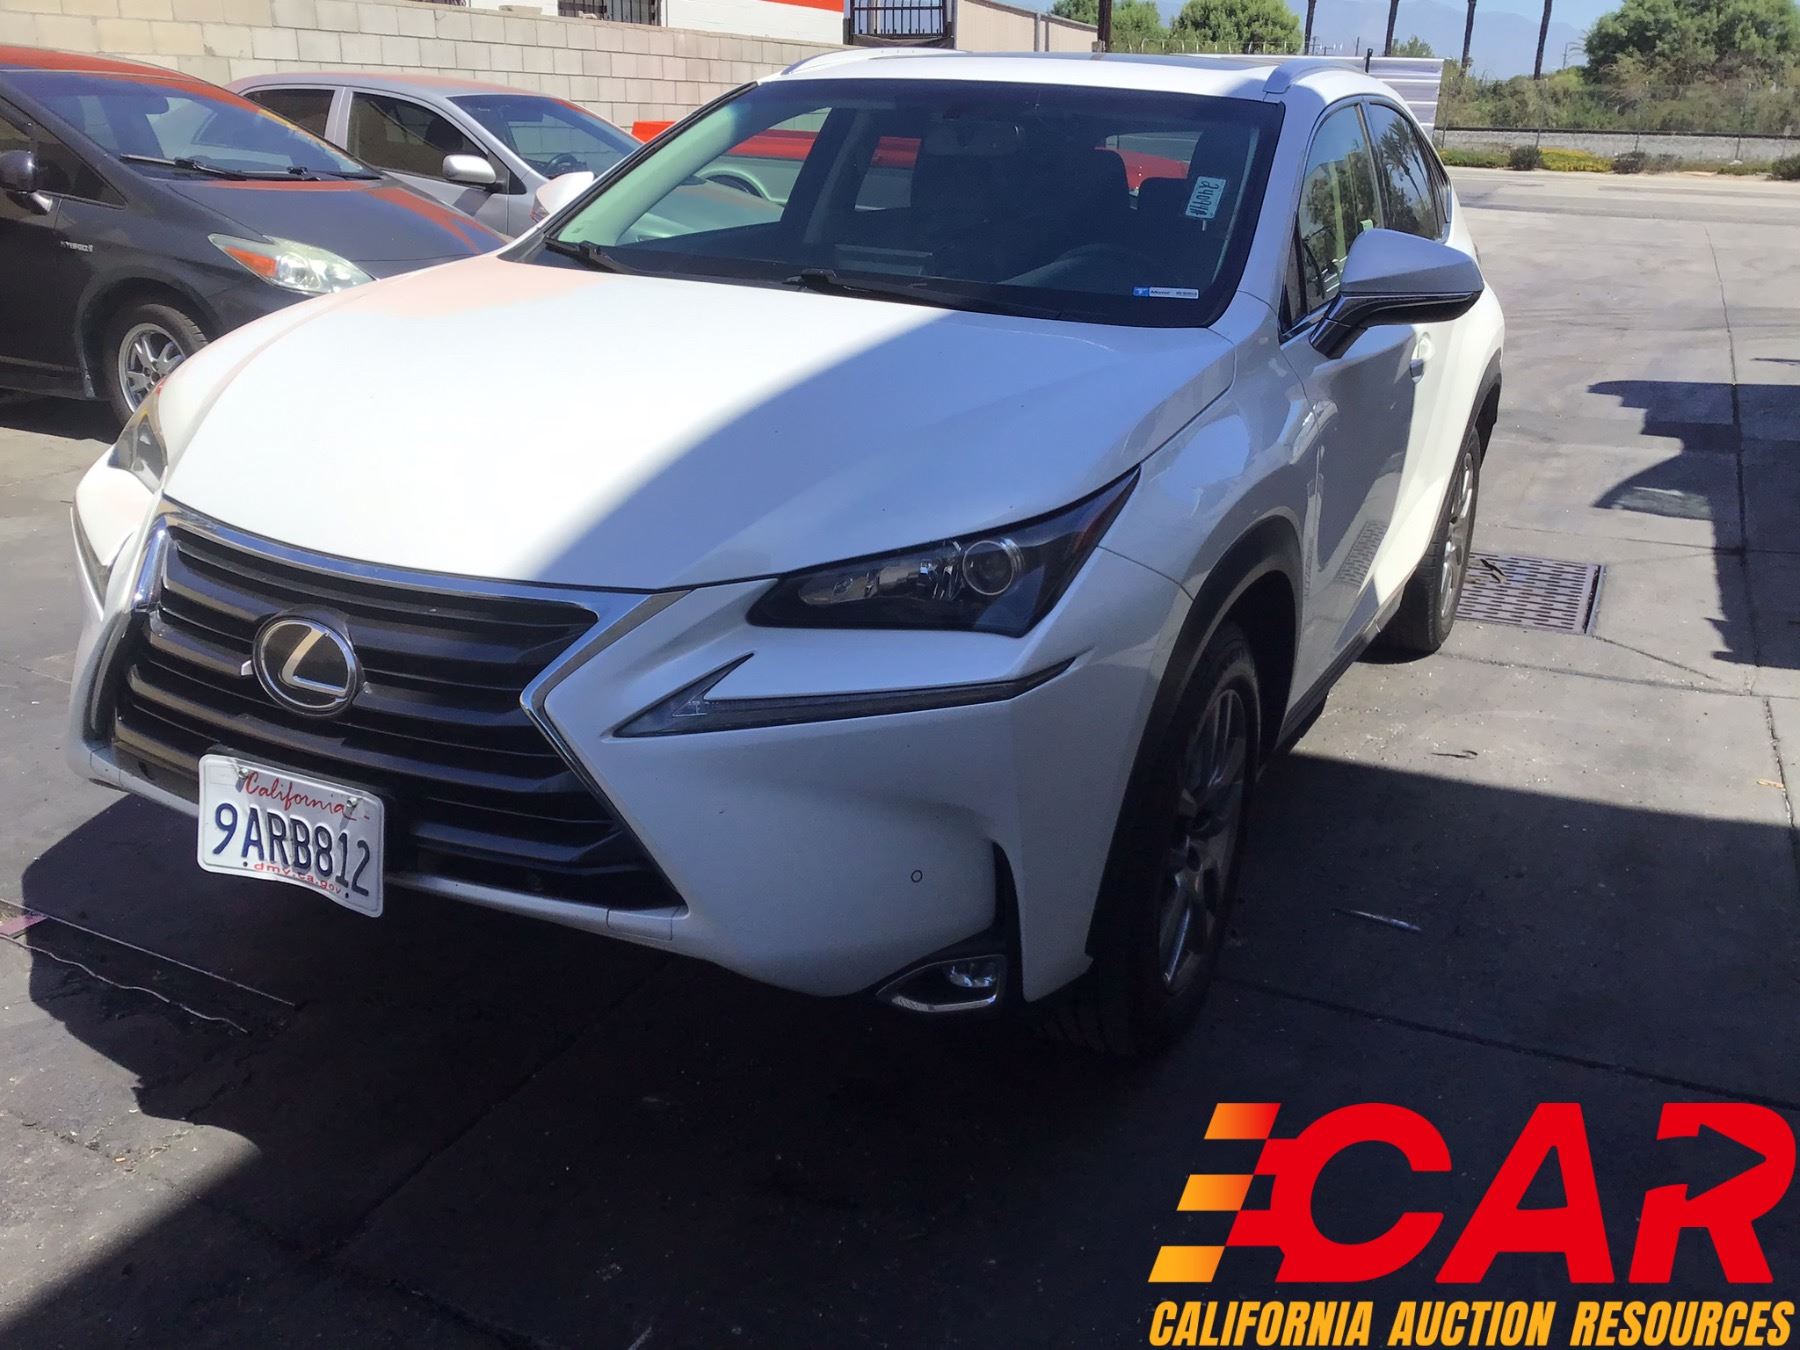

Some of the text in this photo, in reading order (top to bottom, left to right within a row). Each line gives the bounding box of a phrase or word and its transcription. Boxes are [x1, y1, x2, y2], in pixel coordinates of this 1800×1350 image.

[245, 771, 357, 821] California
[212, 802, 371, 897] 9ARB812
[253, 862, 342, 894] dmv.ca.gov
